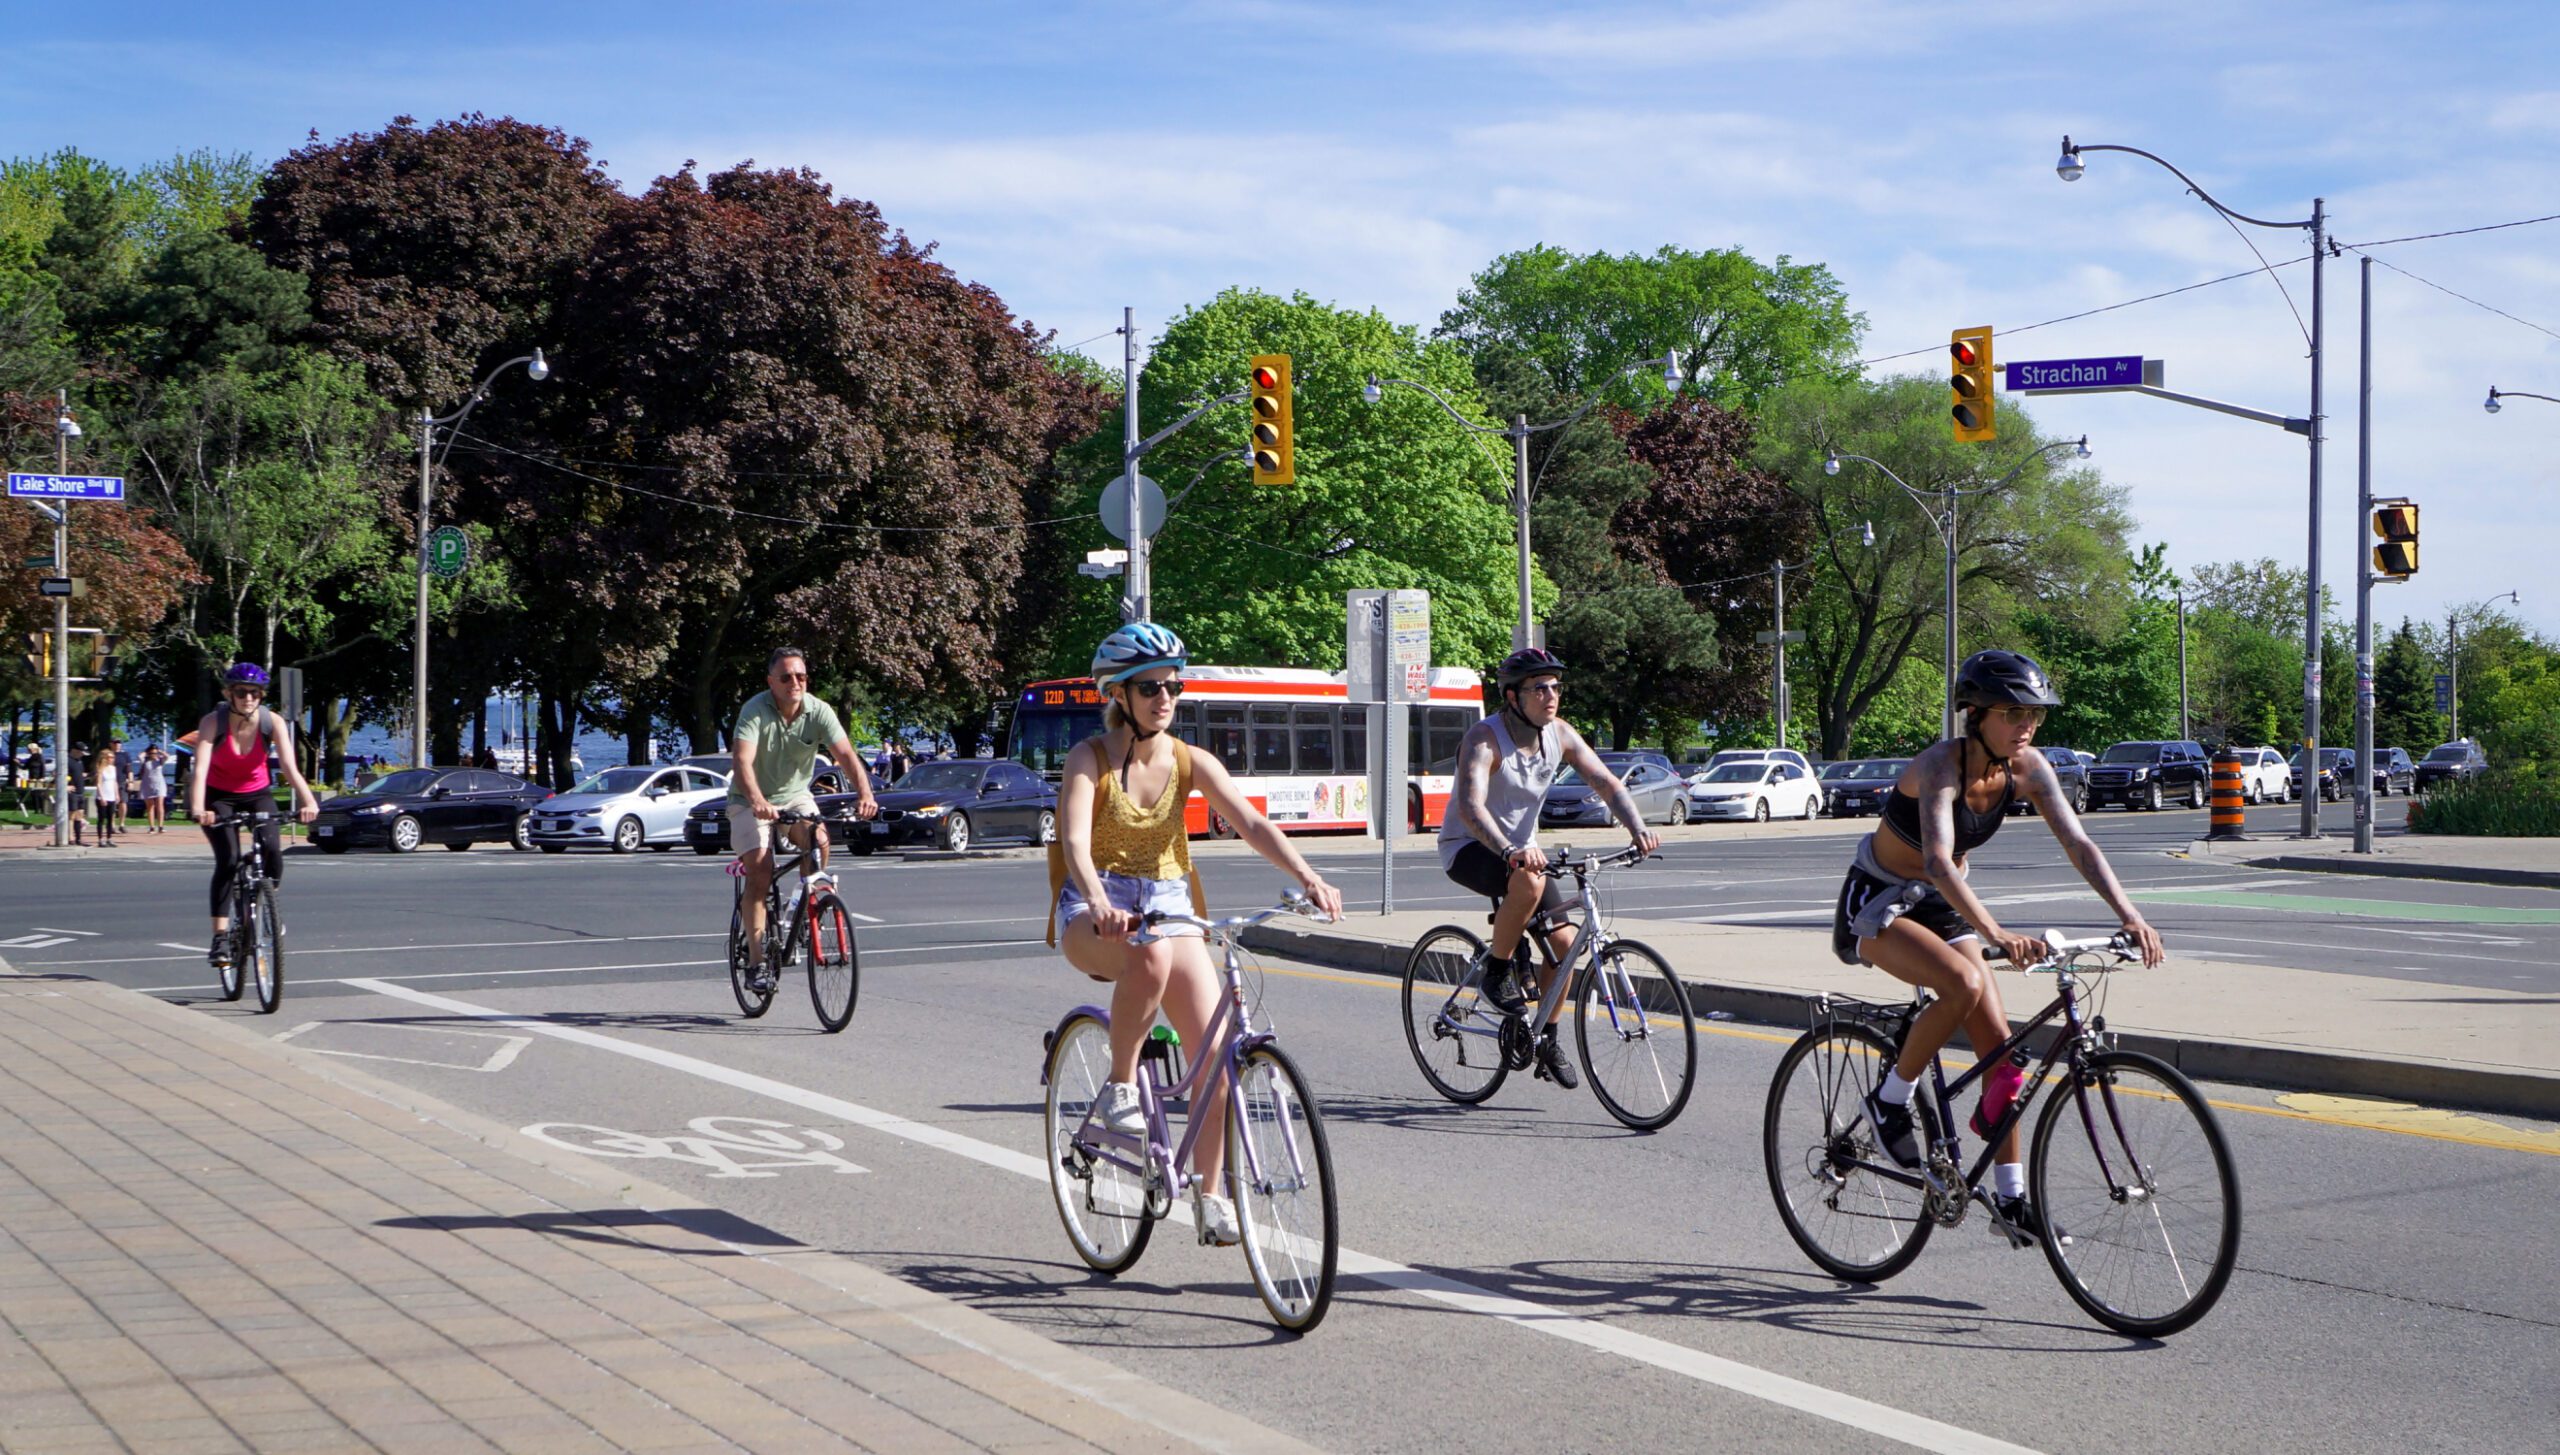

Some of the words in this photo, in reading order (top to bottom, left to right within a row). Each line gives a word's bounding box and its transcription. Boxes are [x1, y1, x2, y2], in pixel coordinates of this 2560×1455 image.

[2021, 363, 2107, 385] Strachan
[2115, 361, 2128, 372] Av
[16, 476, 46, 491] Lake
[47, 477, 86, 493] Shore
[87, 479, 103, 487] Blvd
[103, 479, 116, 494] W
[441, 539, 457, 559] P
